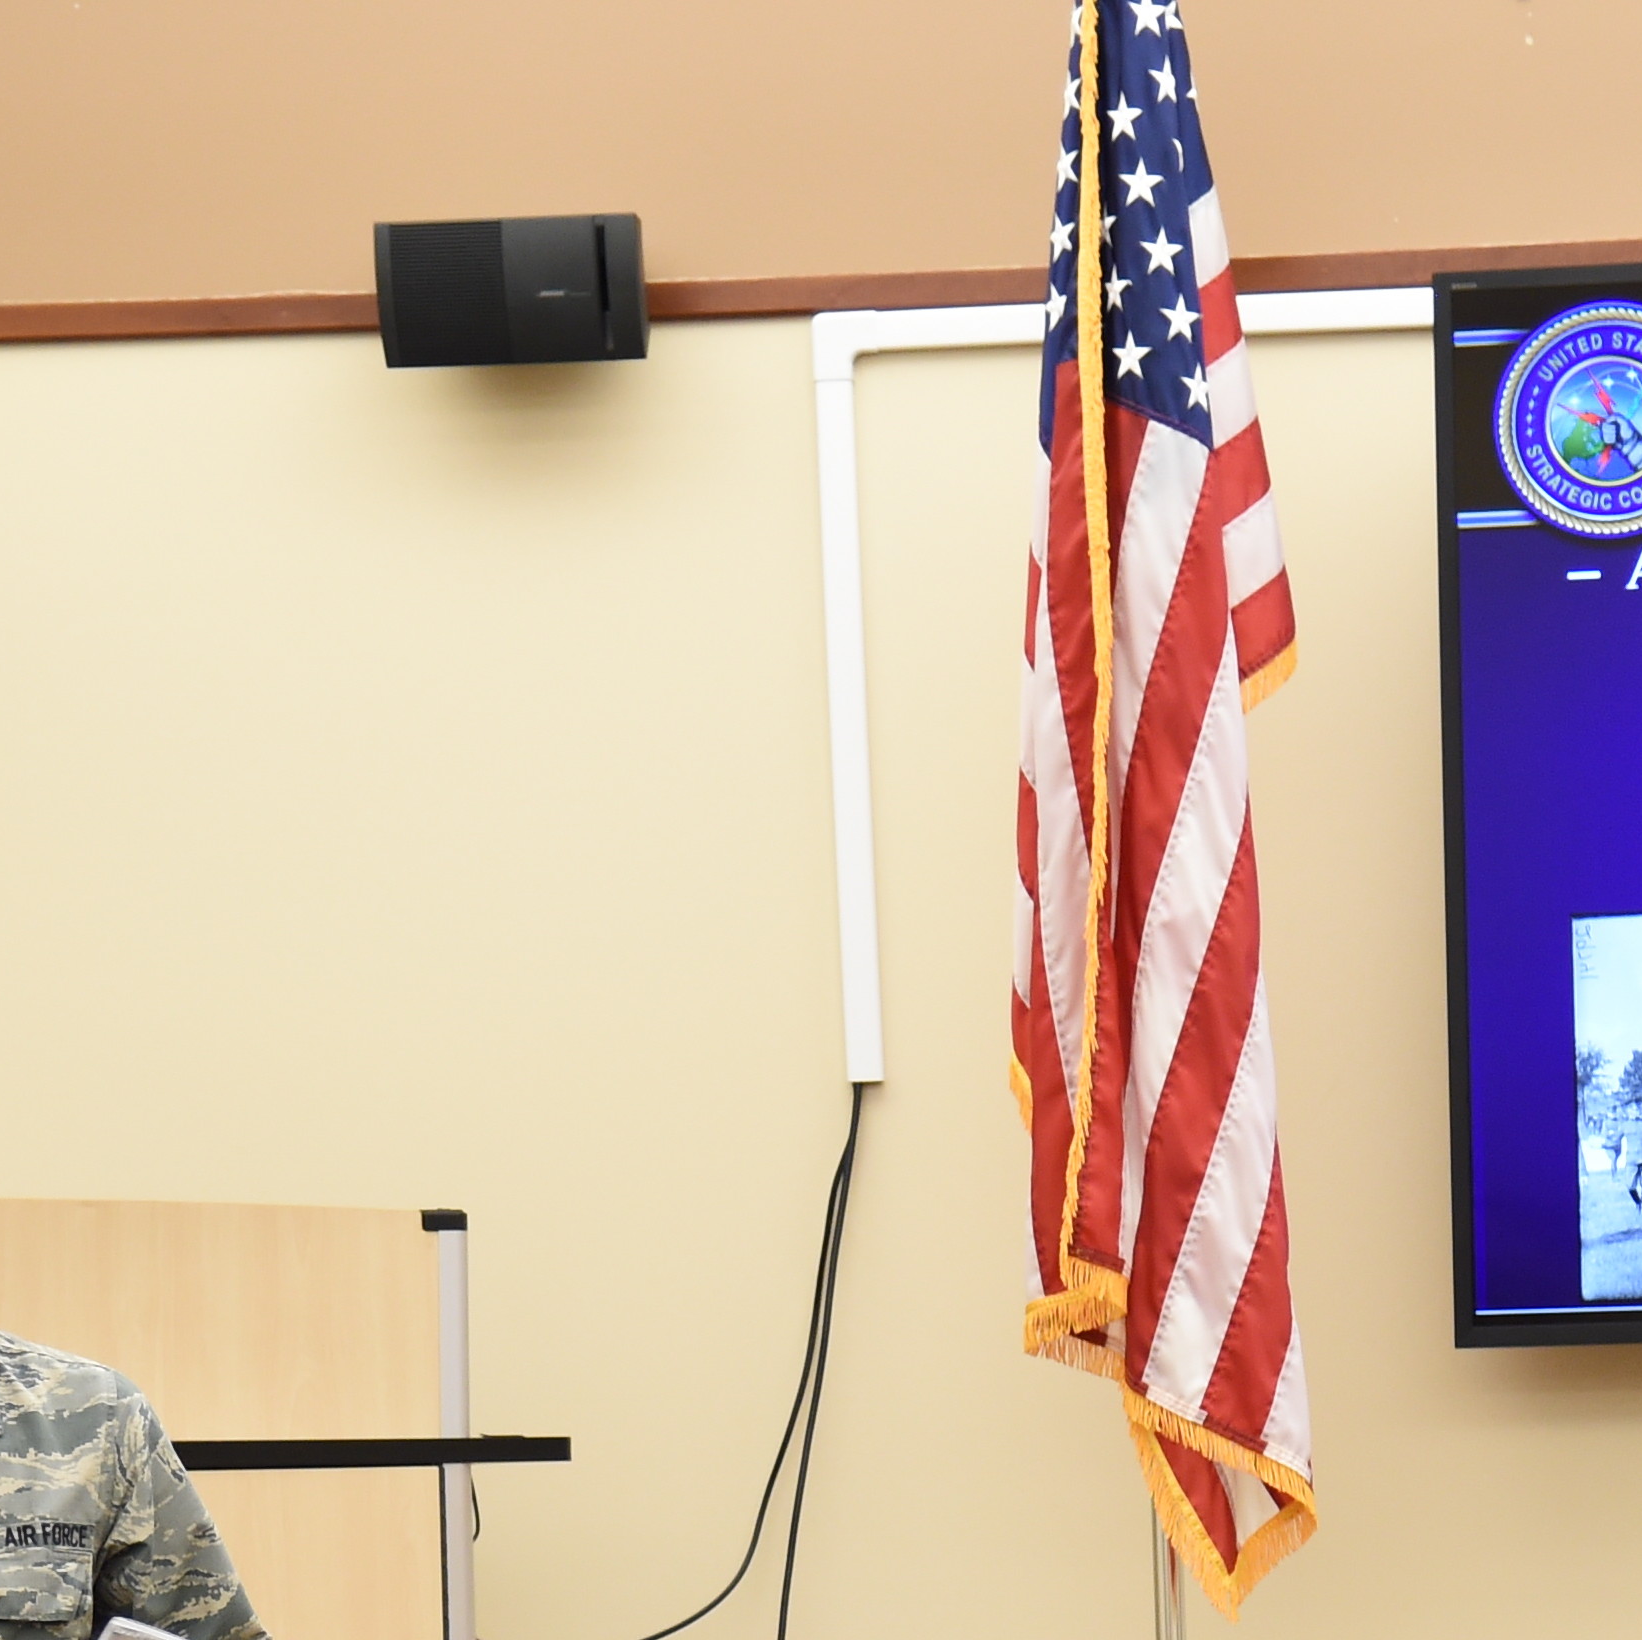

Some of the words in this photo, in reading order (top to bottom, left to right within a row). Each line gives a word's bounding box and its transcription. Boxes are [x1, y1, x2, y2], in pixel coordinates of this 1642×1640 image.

[1538, 332, 1603, 382] UNITED
[1526, 443, 1613, 510] STRATEGIC
[5, 1525, 38, 1547] AIR
[42, 1522, 88, 1549] FORCE
